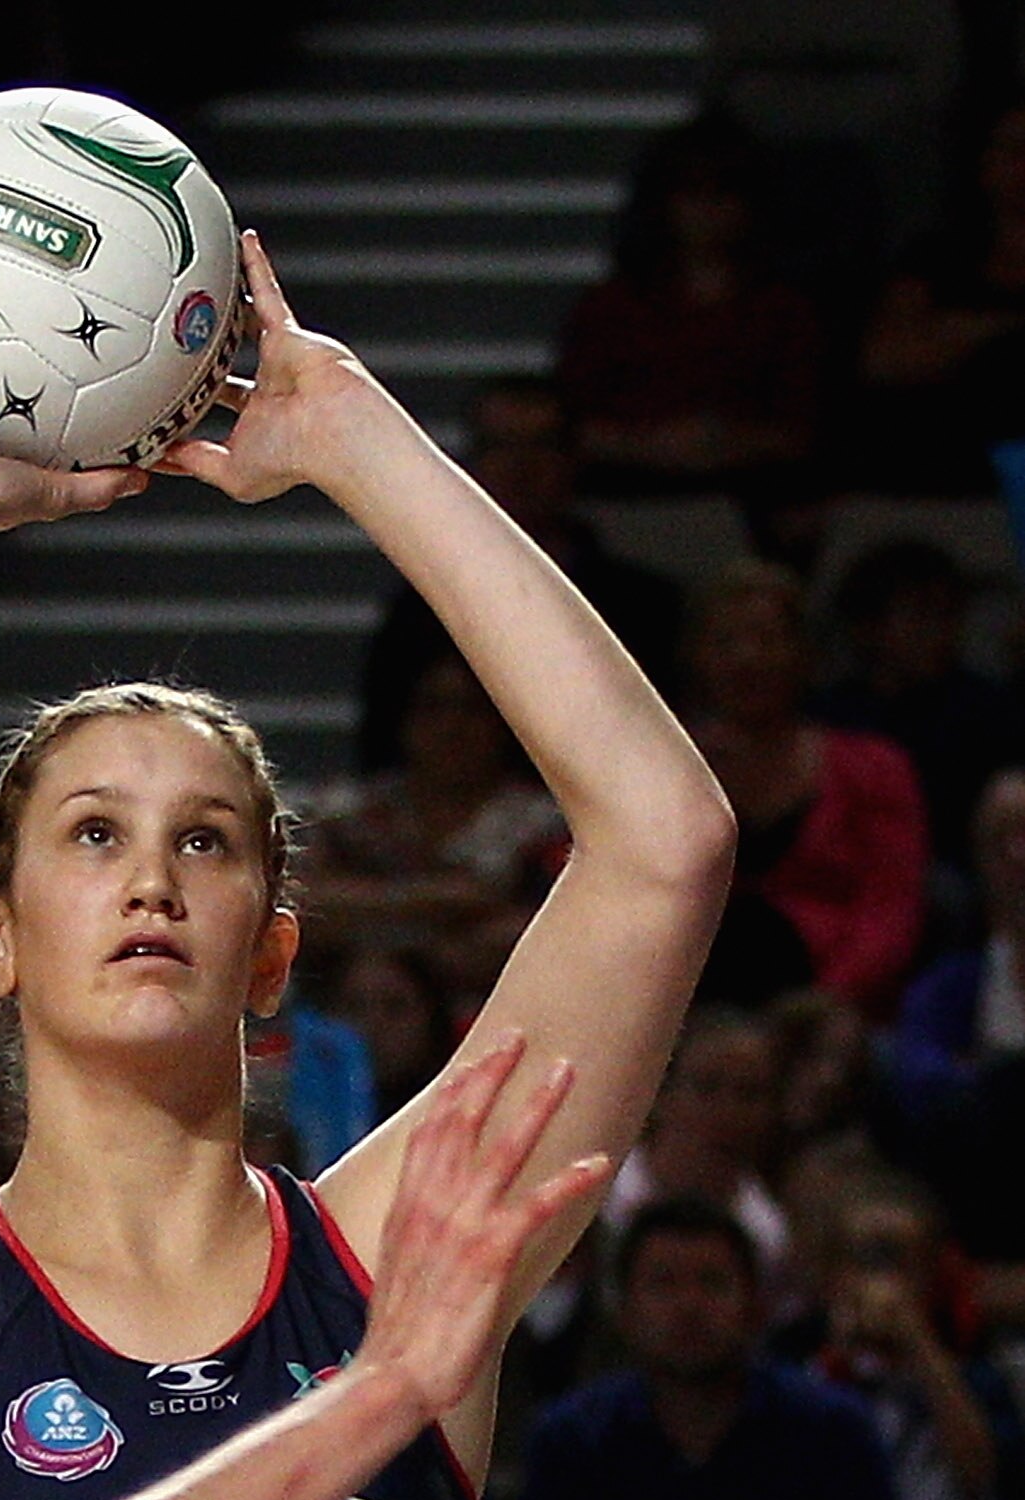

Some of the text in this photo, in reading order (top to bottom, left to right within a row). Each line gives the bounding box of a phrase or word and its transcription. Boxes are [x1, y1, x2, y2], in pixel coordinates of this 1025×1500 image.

[15, 214, 69, 253] SAN
[148, 1392, 240, 1415] SCODY
[41, 1425, 88, 1441] ANZ
